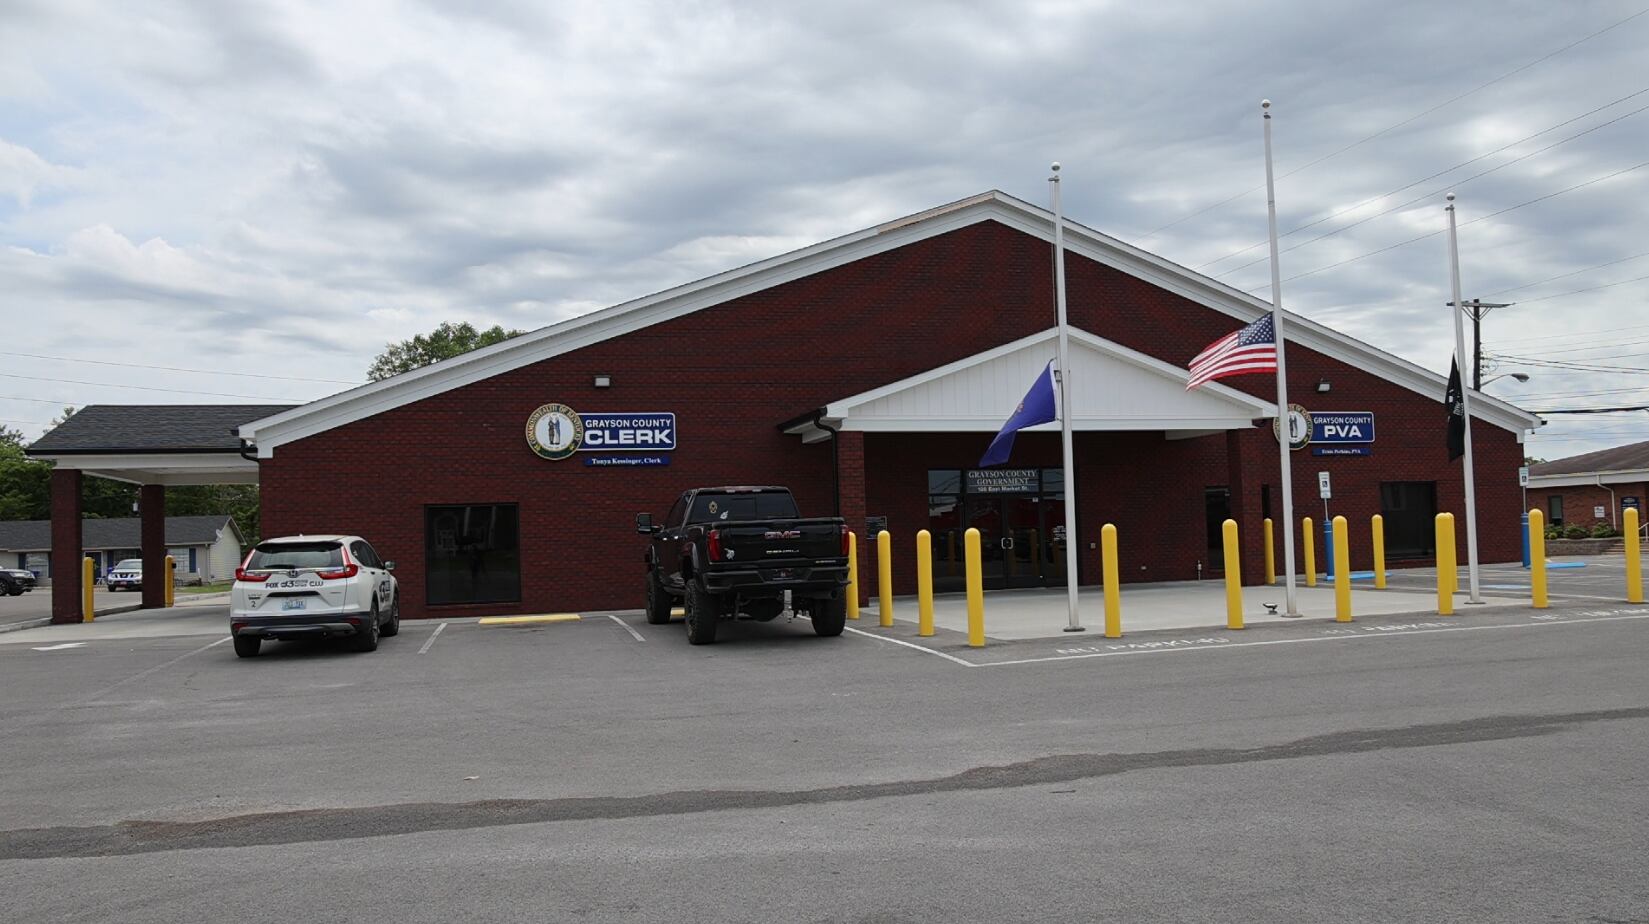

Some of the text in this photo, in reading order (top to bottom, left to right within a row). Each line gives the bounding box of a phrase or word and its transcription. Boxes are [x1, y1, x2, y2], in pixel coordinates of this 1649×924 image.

[585, 418, 671, 428] GRAYSON COUNTY
[1313, 417, 1371, 425] GRAYSON COUNTY
[1324, 425, 1362, 438] PVA
[584, 429, 672, 445] CLERK
[644, 457, 662, 465] Clerk
[968, 469, 1036, 478] GRAYSON COUNTY
[765, 530, 801, 540] GMC
[251, 600, 256, 608] 2
[1107, 637, 1231, 650] PARKING
